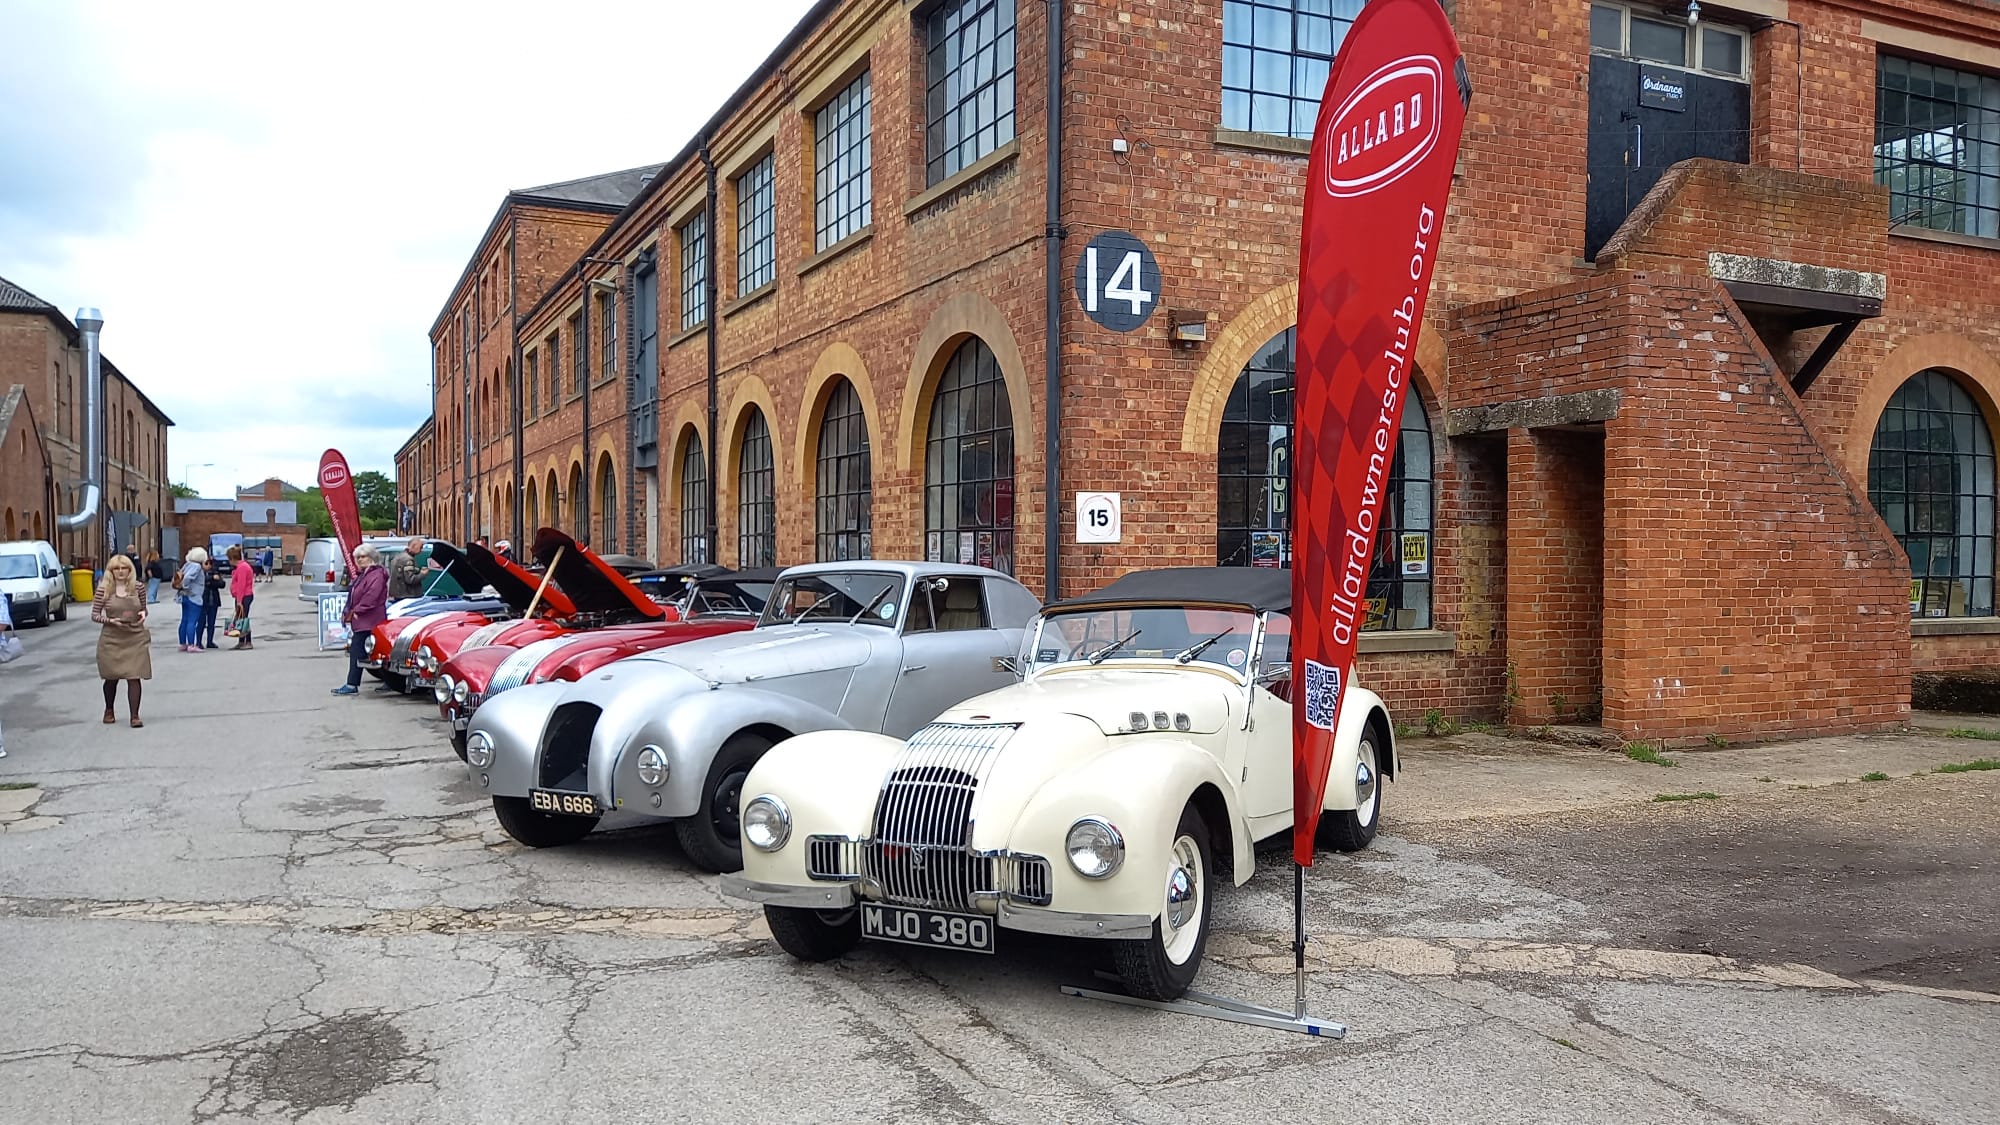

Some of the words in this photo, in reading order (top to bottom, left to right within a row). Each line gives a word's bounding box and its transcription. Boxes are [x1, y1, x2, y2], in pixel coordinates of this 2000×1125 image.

[1643, 78, 1684, 94] Ordnance
[1337, 93, 1422, 165] ALLARD
[1086, 247, 1152, 315] 14
[1333, 203, 1433, 645] allardownersclub.org
[1088, 509, 1109, 527] 15
[1403, 542, 1426, 557] CCTV
[533, 792, 561, 812] EBA
[563, 796, 593, 815] 666
[865, 907, 920, 939] MJO
[929, 915, 988, 948] 380
